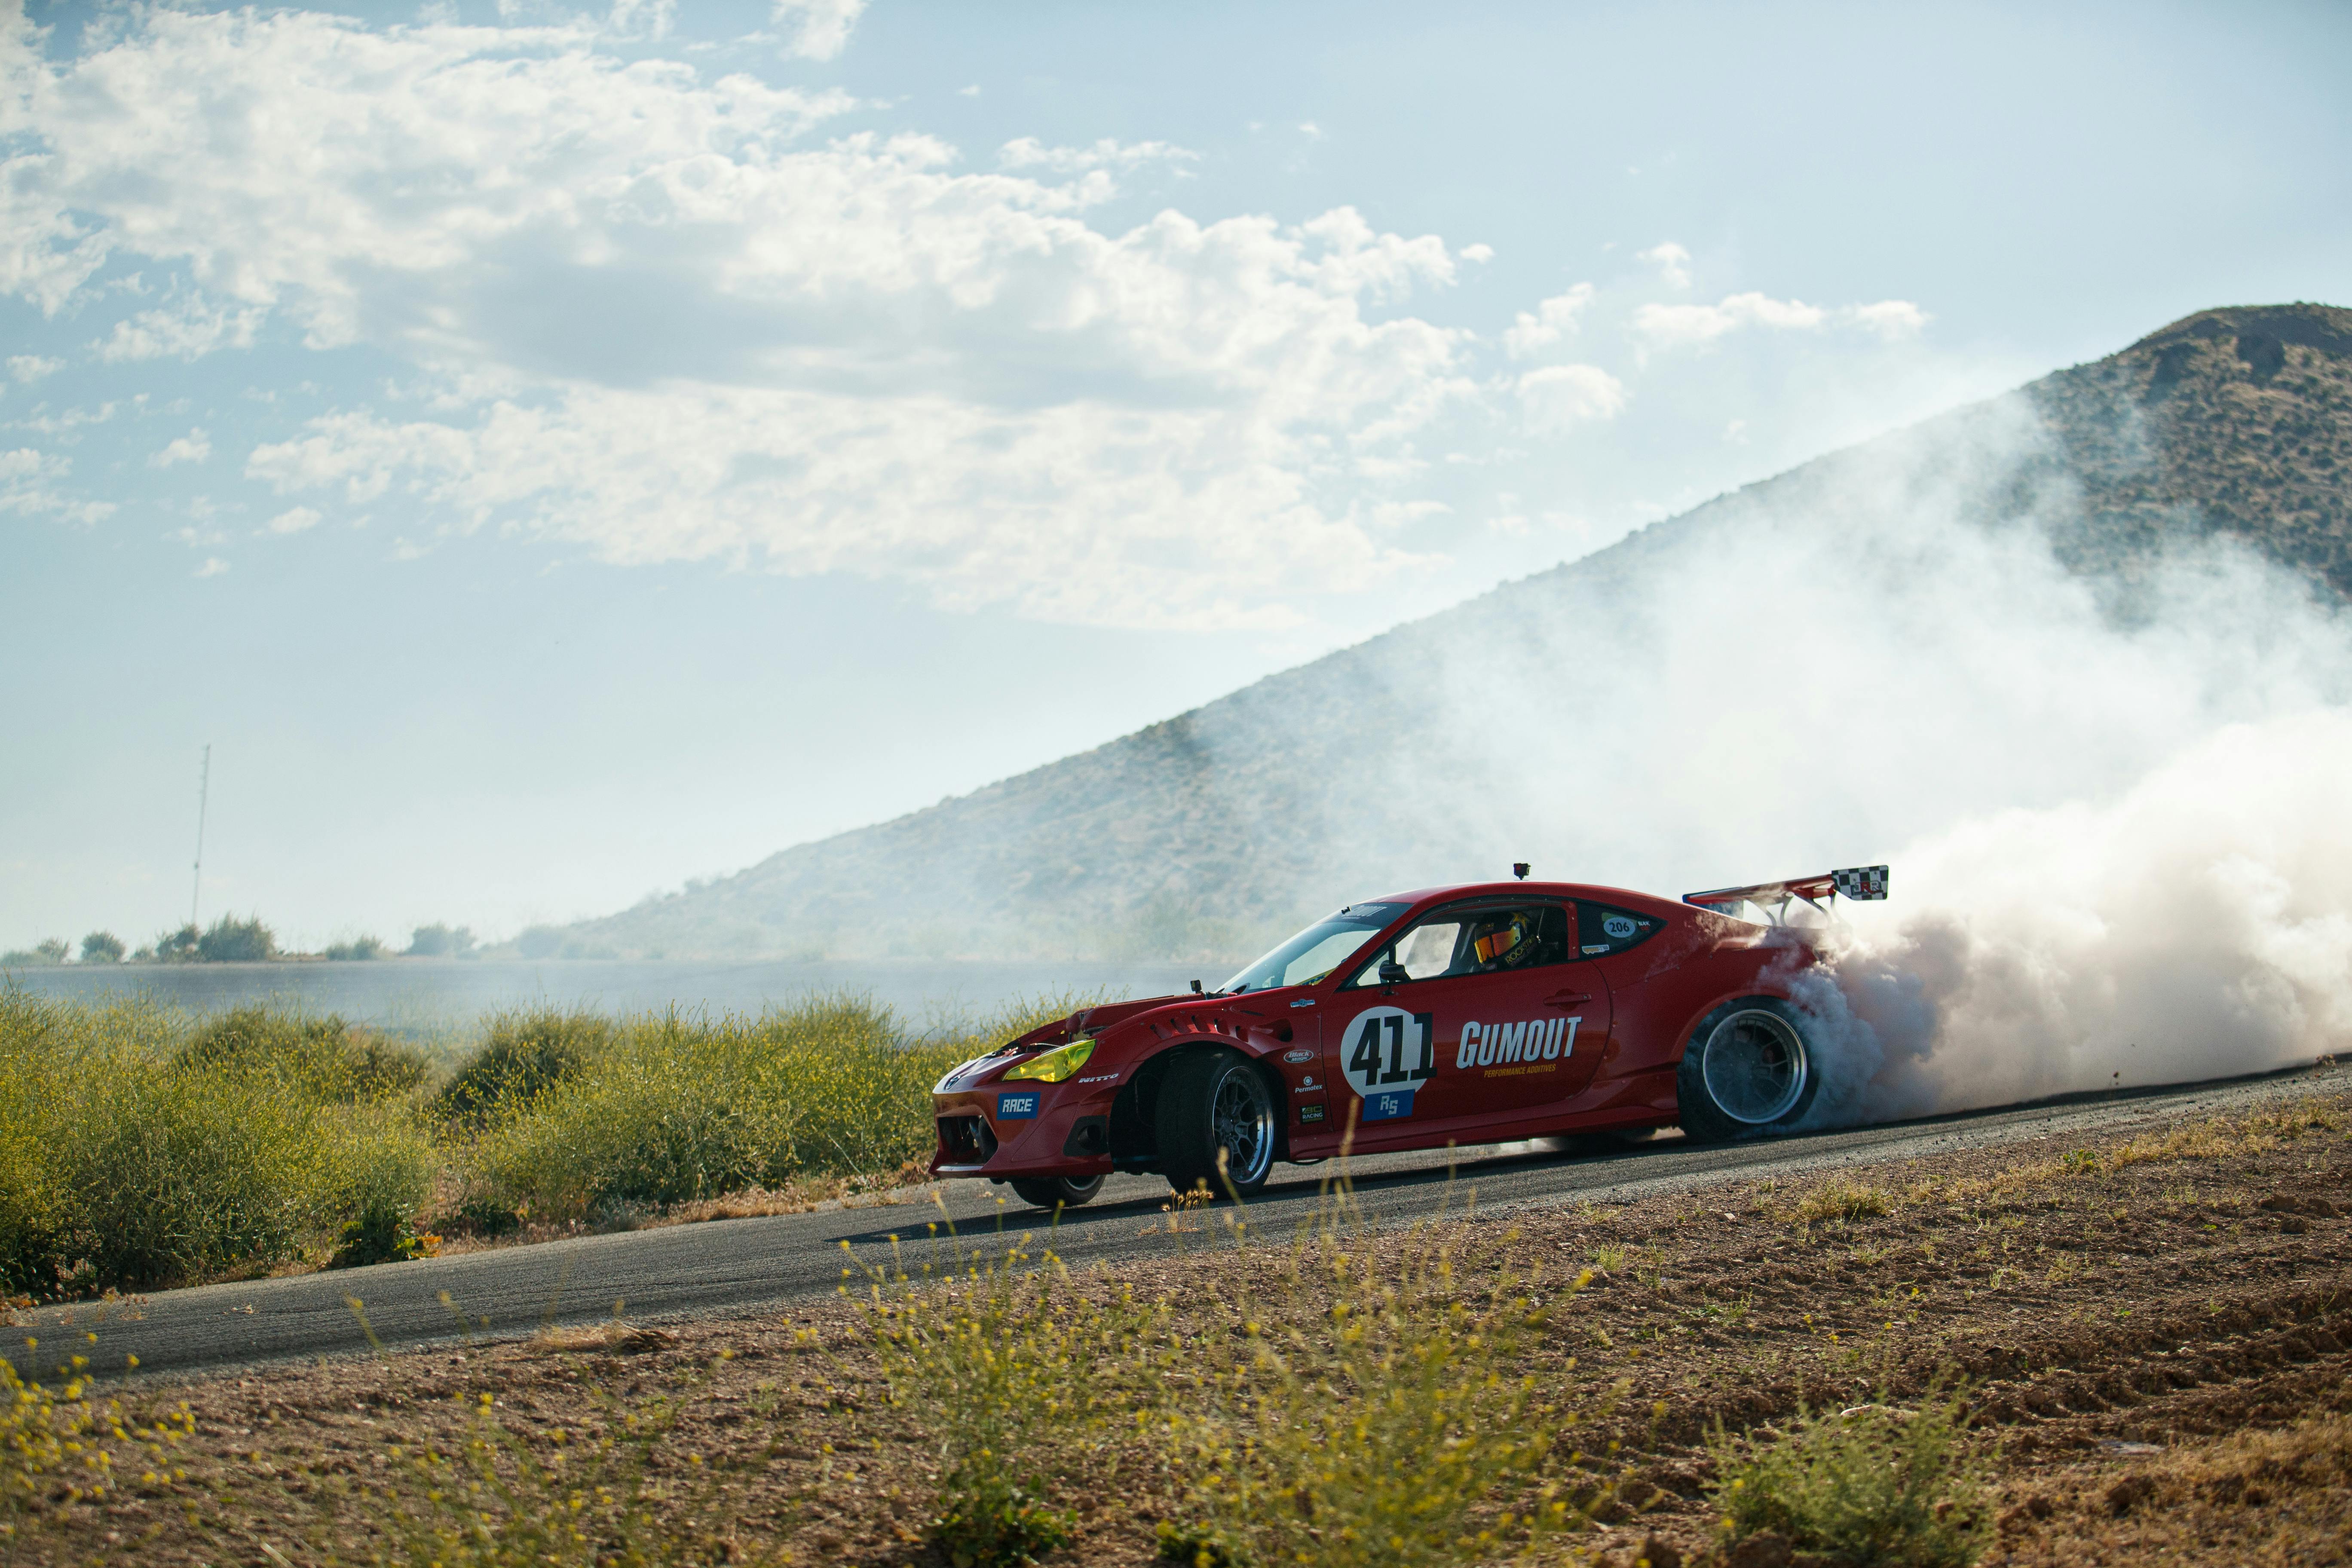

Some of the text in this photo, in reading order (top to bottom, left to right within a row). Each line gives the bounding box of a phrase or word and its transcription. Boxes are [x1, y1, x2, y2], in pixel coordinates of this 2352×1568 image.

[1609, 922, 1629, 933] 206
[1350, 1012, 1437, 1086] 411
[1456, 1016, 1582, 1069] GUMOUT
[1484, 1064, 1556, 1078] PERFORMANCE ADDITIVES
[1295, 1084, 1323, 1093] Permatex
[1002, 1098, 1033, 1113] RACE
